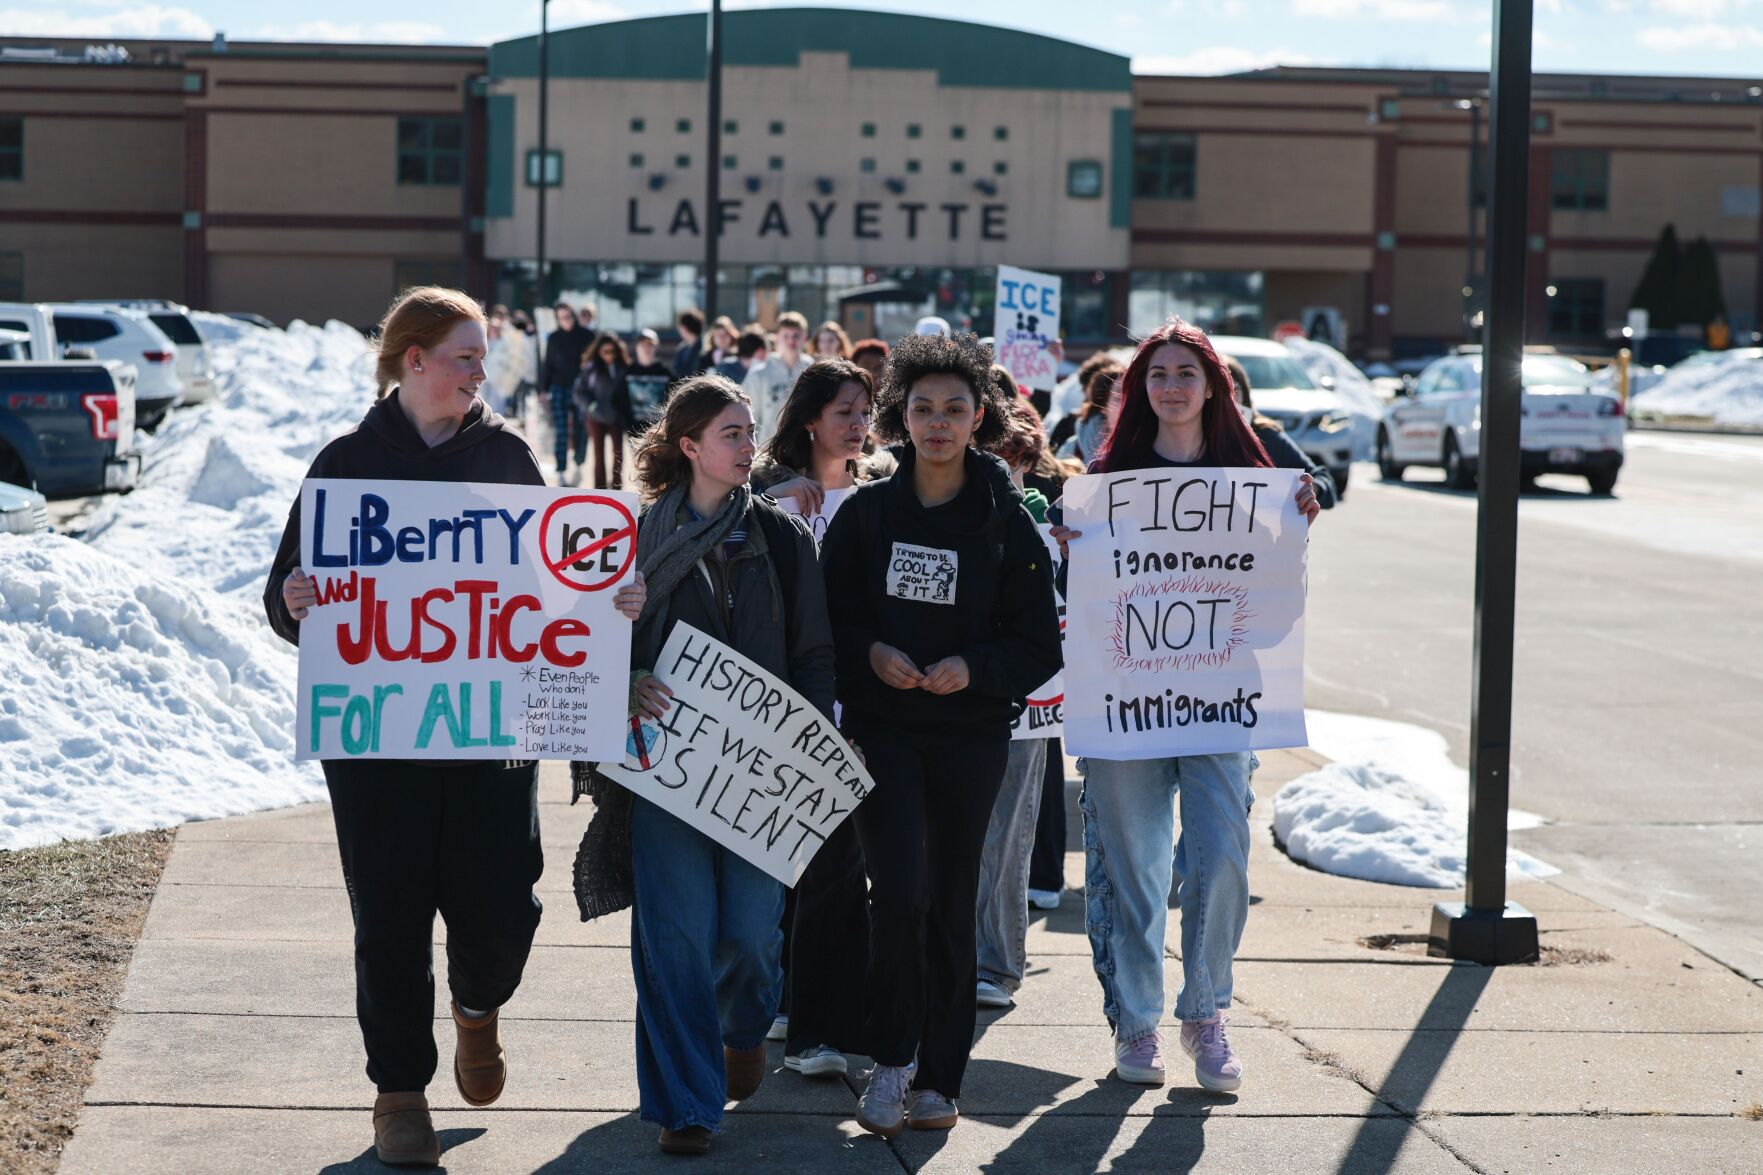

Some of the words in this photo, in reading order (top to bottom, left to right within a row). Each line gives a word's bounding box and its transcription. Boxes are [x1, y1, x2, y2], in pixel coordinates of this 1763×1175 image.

[627, 197, 1008, 241] LAFAYETTE
[1000, 280, 1056, 317] ICE
[1108, 477, 1268, 537] FIGHT
[561, 523, 619, 573] ICE
[896, 548, 925, 560] TRYING
[893, 559, 930, 576] COOL
[1113, 549, 1255, 578] ignorance
[900, 575, 931, 585] ABOUT
[913, 586, 930, 598] IT
[1125, 598, 1231, 656] NOT
[539, 667, 567, 682] Even
[670, 635, 803, 732] HISTORY
[414, 681, 517, 749] ALL
[572, 701, 588, 710] you
[572, 714, 587, 724] you
[525, 720, 546, 736] Pray
[571, 728, 586, 736] you
[525, 737, 549, 752] Love
[572, 745, 588, 755] you
[657, 696, 719, 743] IF
[721, 727, 773, 776] WE
[765, 764, 848, 825] STAY
[654, 748, 826, 861] SILENT
